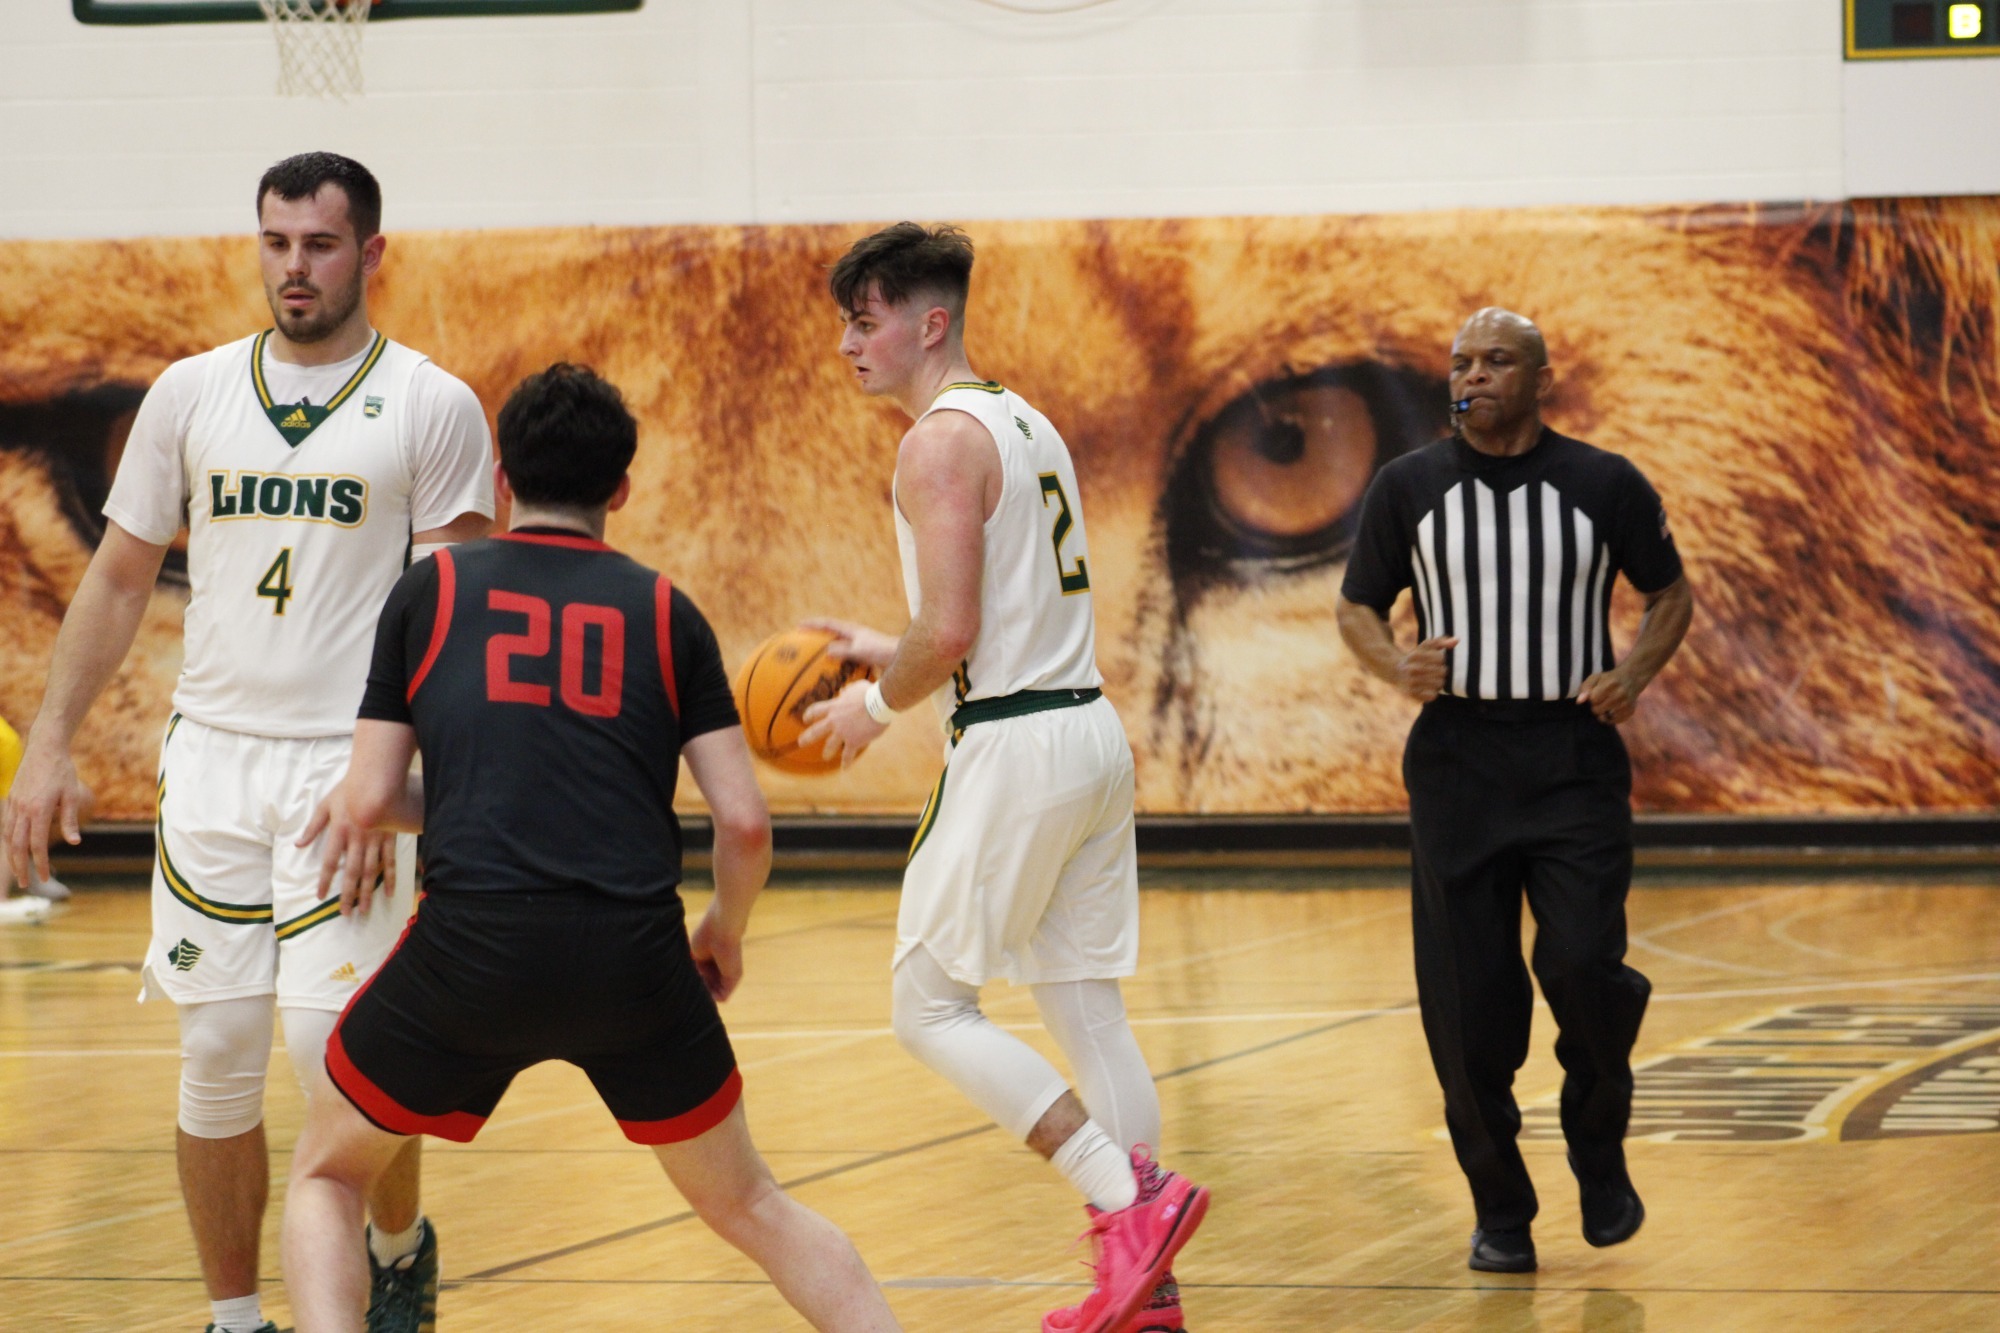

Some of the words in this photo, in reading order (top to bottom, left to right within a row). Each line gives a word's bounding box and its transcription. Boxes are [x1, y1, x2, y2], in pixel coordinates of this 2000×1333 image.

[280, 420, 311, 428] adidas
[209, 470, 369, 528] LIONS
[1038, 471, 1091, 596] 2
[256, 547, 294, 616] 4
[486, 589, 625, 718] 20
